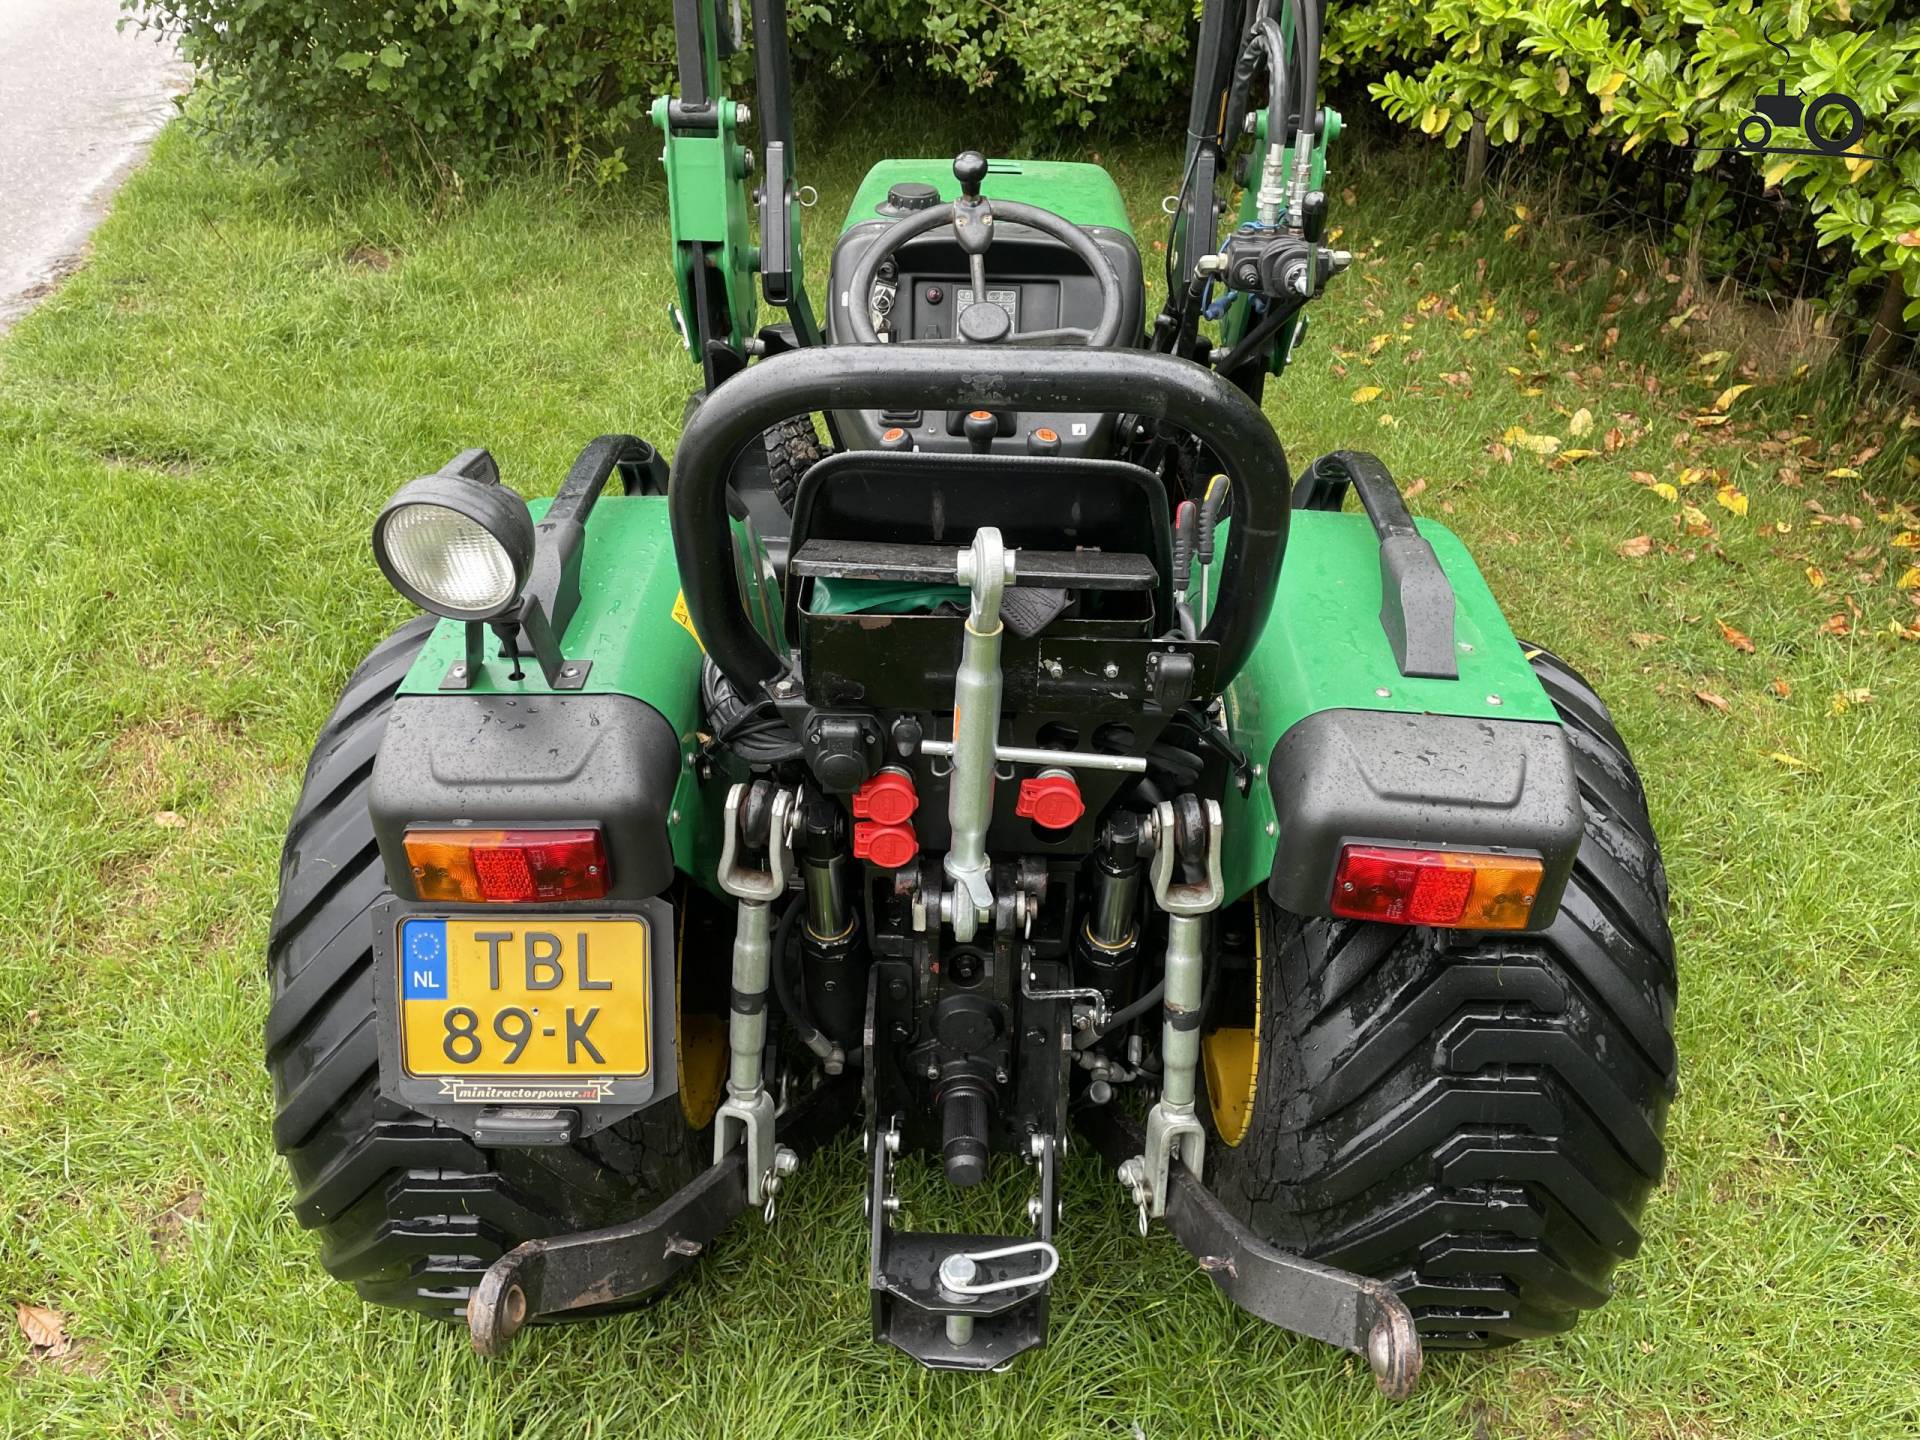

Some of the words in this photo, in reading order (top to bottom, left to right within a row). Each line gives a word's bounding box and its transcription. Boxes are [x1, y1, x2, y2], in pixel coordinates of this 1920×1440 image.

[413, 971, 440, 988] NL
[474, 931, 613, 991] TBL
[442, 1007, 606, 1065] 89-K
[458, 1086, 598, 1099] minitractorpower.nl
